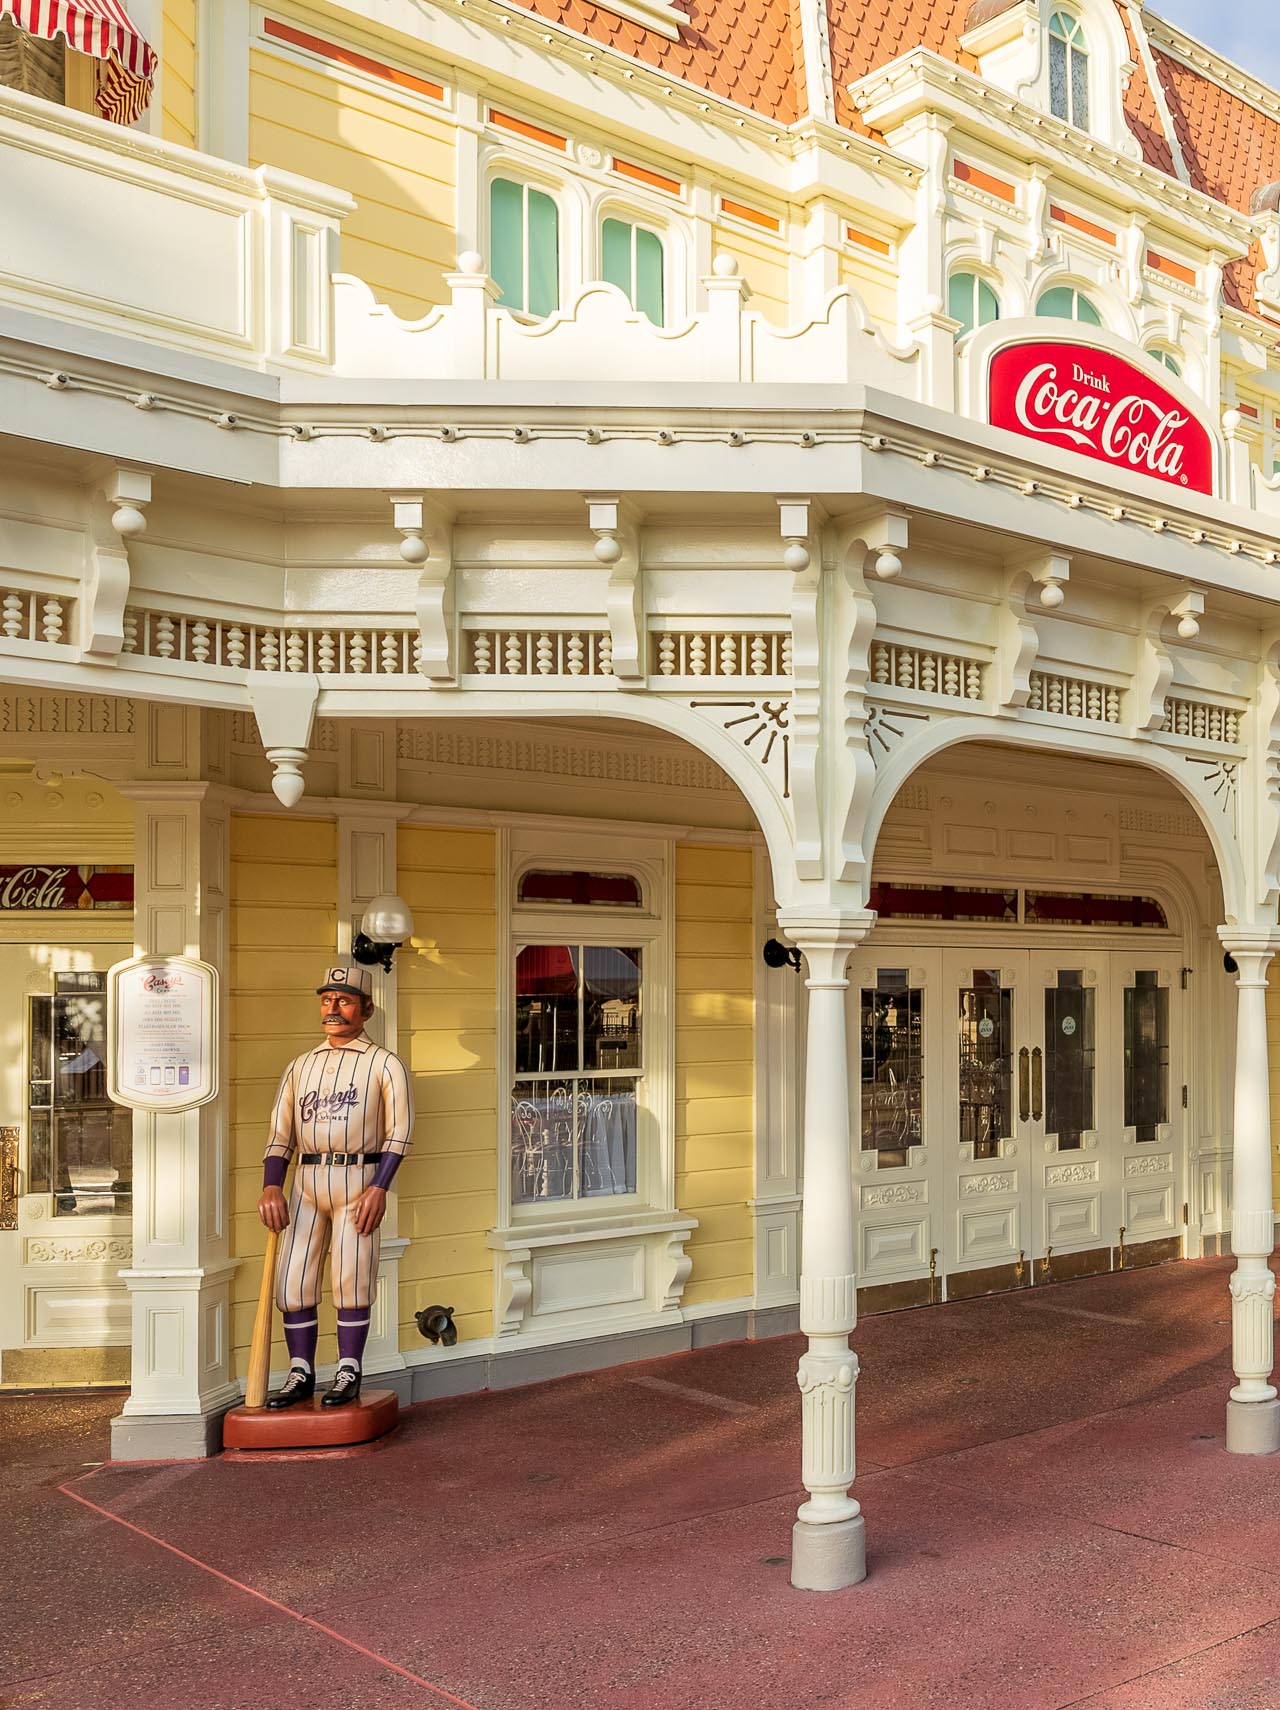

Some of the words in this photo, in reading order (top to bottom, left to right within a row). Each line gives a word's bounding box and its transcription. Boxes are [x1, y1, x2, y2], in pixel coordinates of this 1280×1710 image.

[1071, 363, 1111, 393] Drink
[1015, 363, 1189, 477] Coca-Cola
[330, 968, 346, 982] C
[299, 1083, 359, 1124] Casey's
